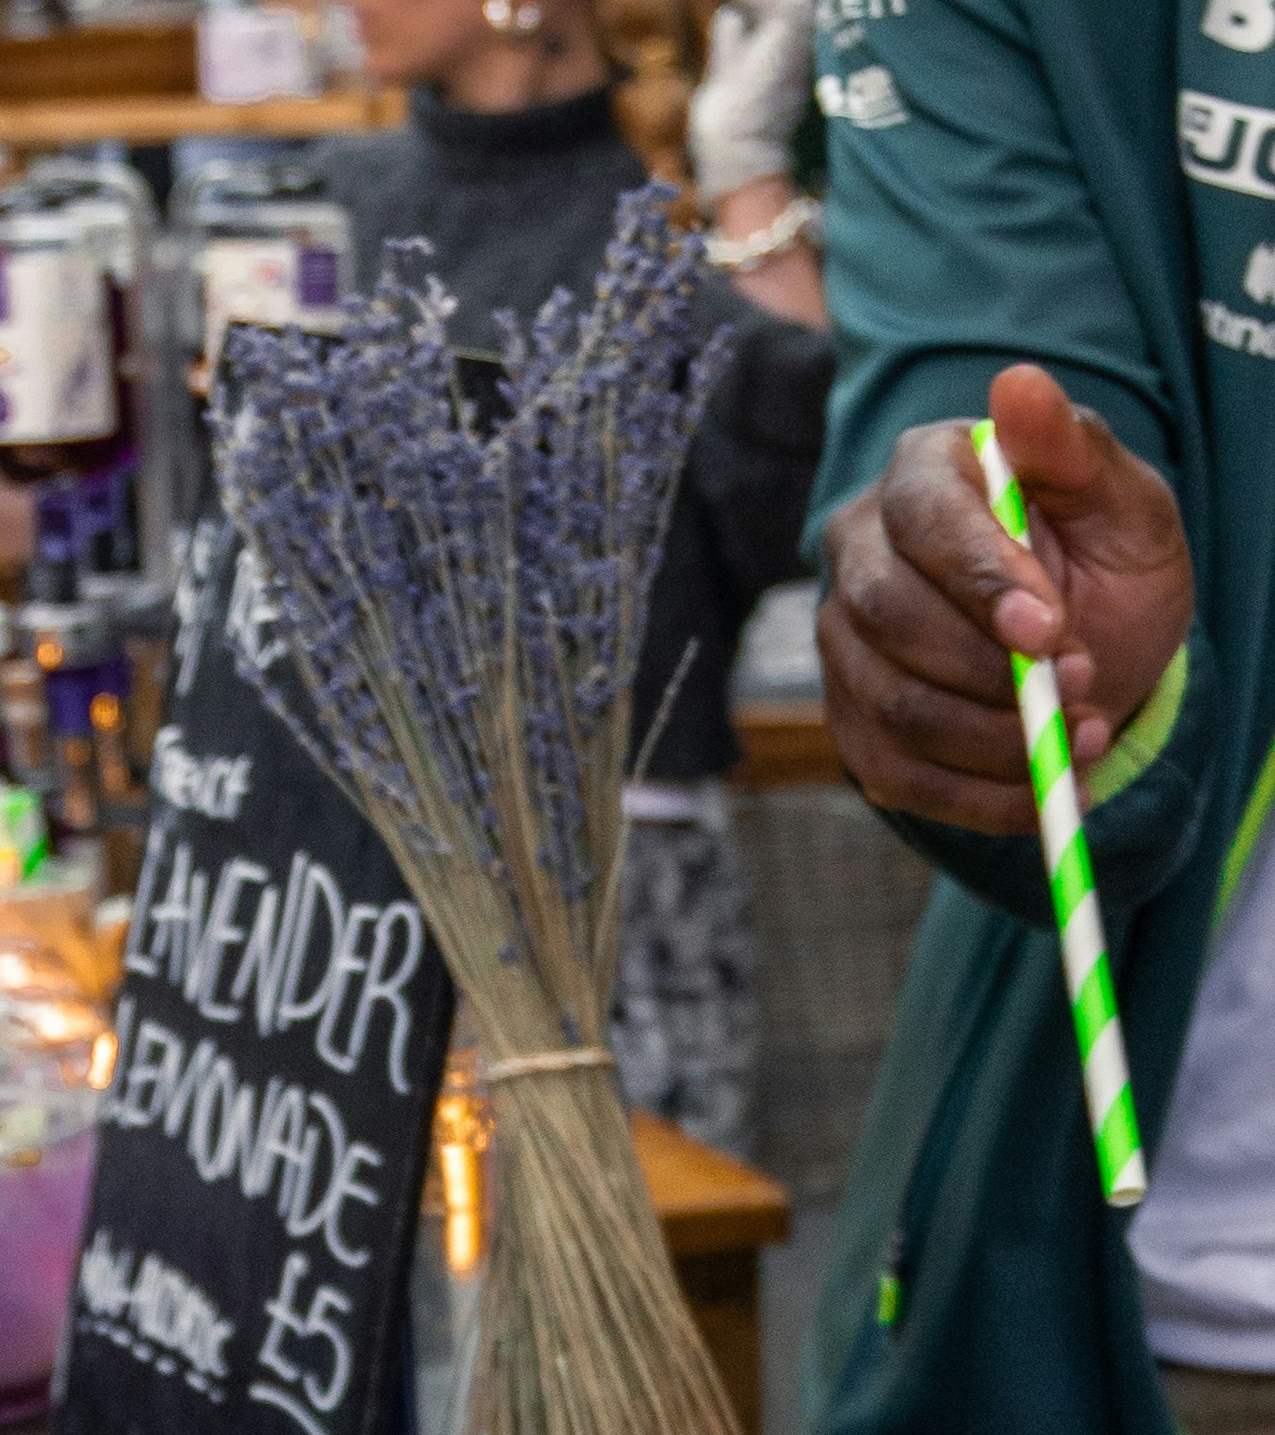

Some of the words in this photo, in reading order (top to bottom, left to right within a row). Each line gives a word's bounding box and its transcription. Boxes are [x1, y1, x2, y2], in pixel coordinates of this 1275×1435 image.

[126, 824, 423, 1095] LAVENDER
[100, 996, 384, 1267] LEMONADE
[259, 1252, 354, 1412] £5
